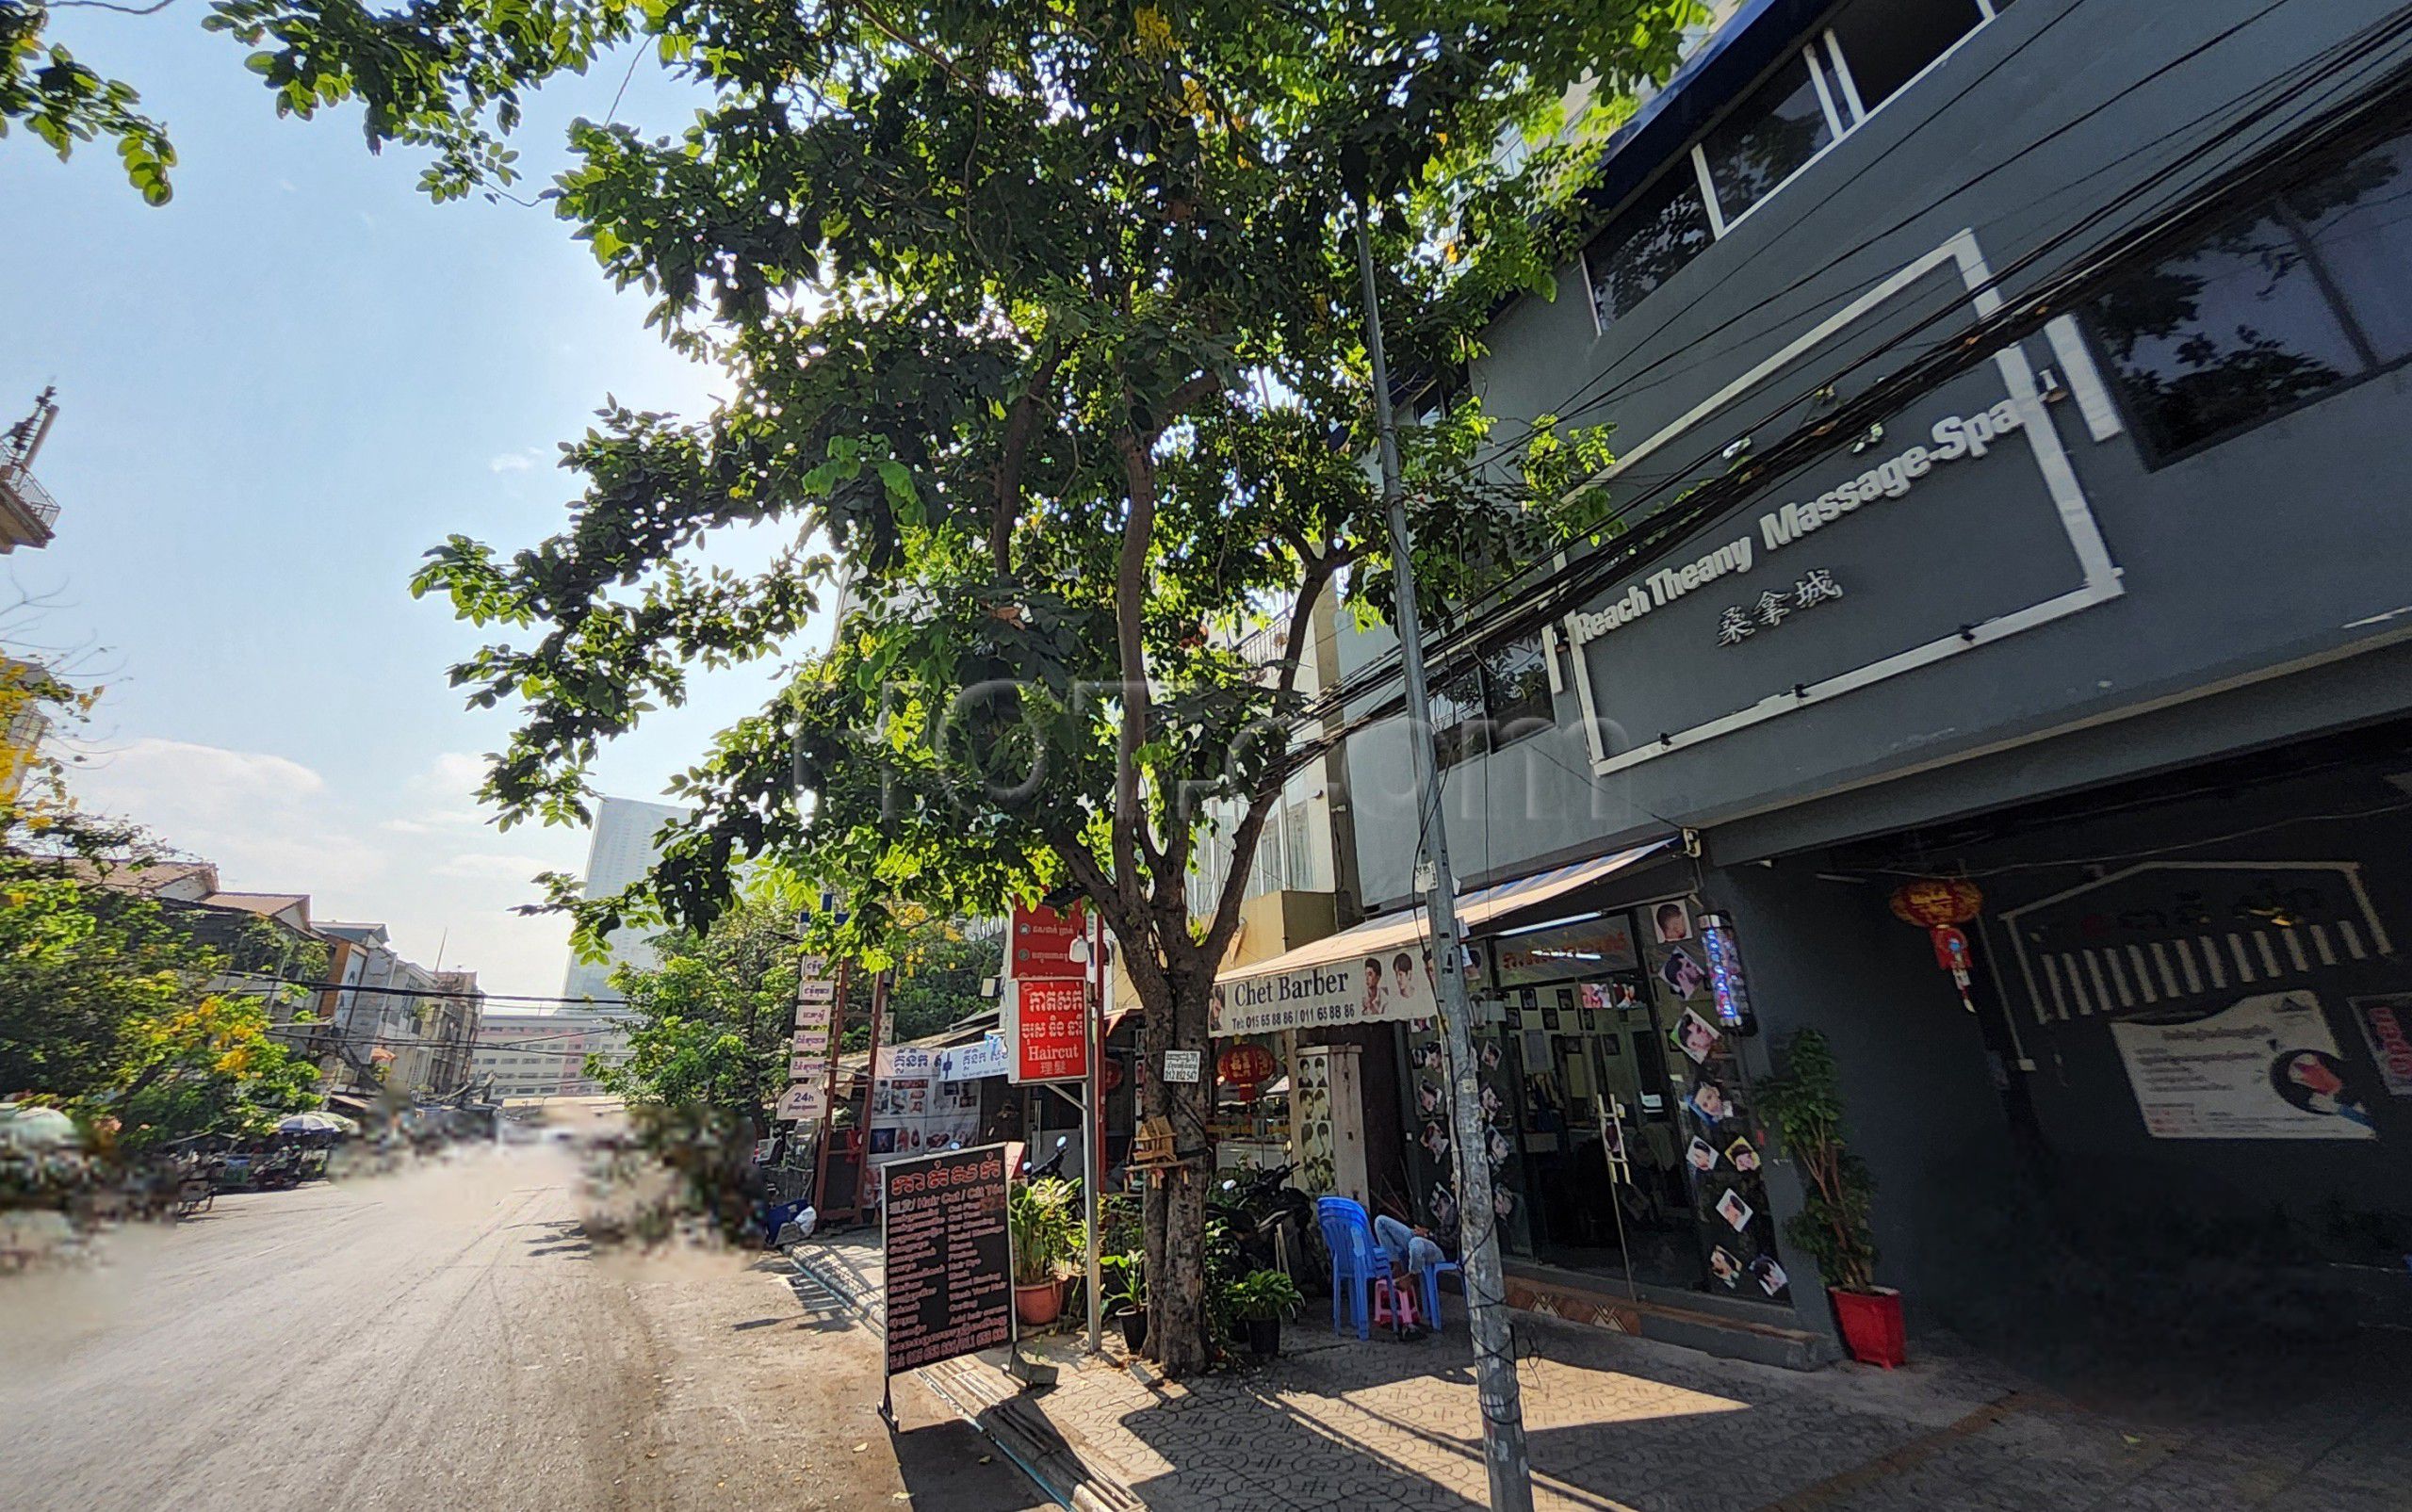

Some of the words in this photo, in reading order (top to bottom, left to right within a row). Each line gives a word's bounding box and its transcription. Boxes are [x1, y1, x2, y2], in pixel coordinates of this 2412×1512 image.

[1576, 585, 1652, 644] Reach
[1645, 536, 1752, 606] Theany
[1717, 568, 1844, 647] 桑拿城
[1234, 981, 1273, 1007] Chet
[1278, 968, 1349, 1001] Barber
[1246, 1016, 1260, 1029] 015
[1261, 1015, 1270, 1027] 65
[1272, 1013, 1281, 1026] 88
[1283, 1011, 1294, 1024] 86
[1300, 1008, 1314, 1022] 011
[1317, 1006, 1328, 1019] 65
[1329, 1004, 1341, 1018] 88
[1344, 1003, 1355, 1018] 86
[1028, 1043, 1080, 1062] Haircut
[793, 1092, 814, 1102] 24h
[941, 1191, 960, 1204] Cut
